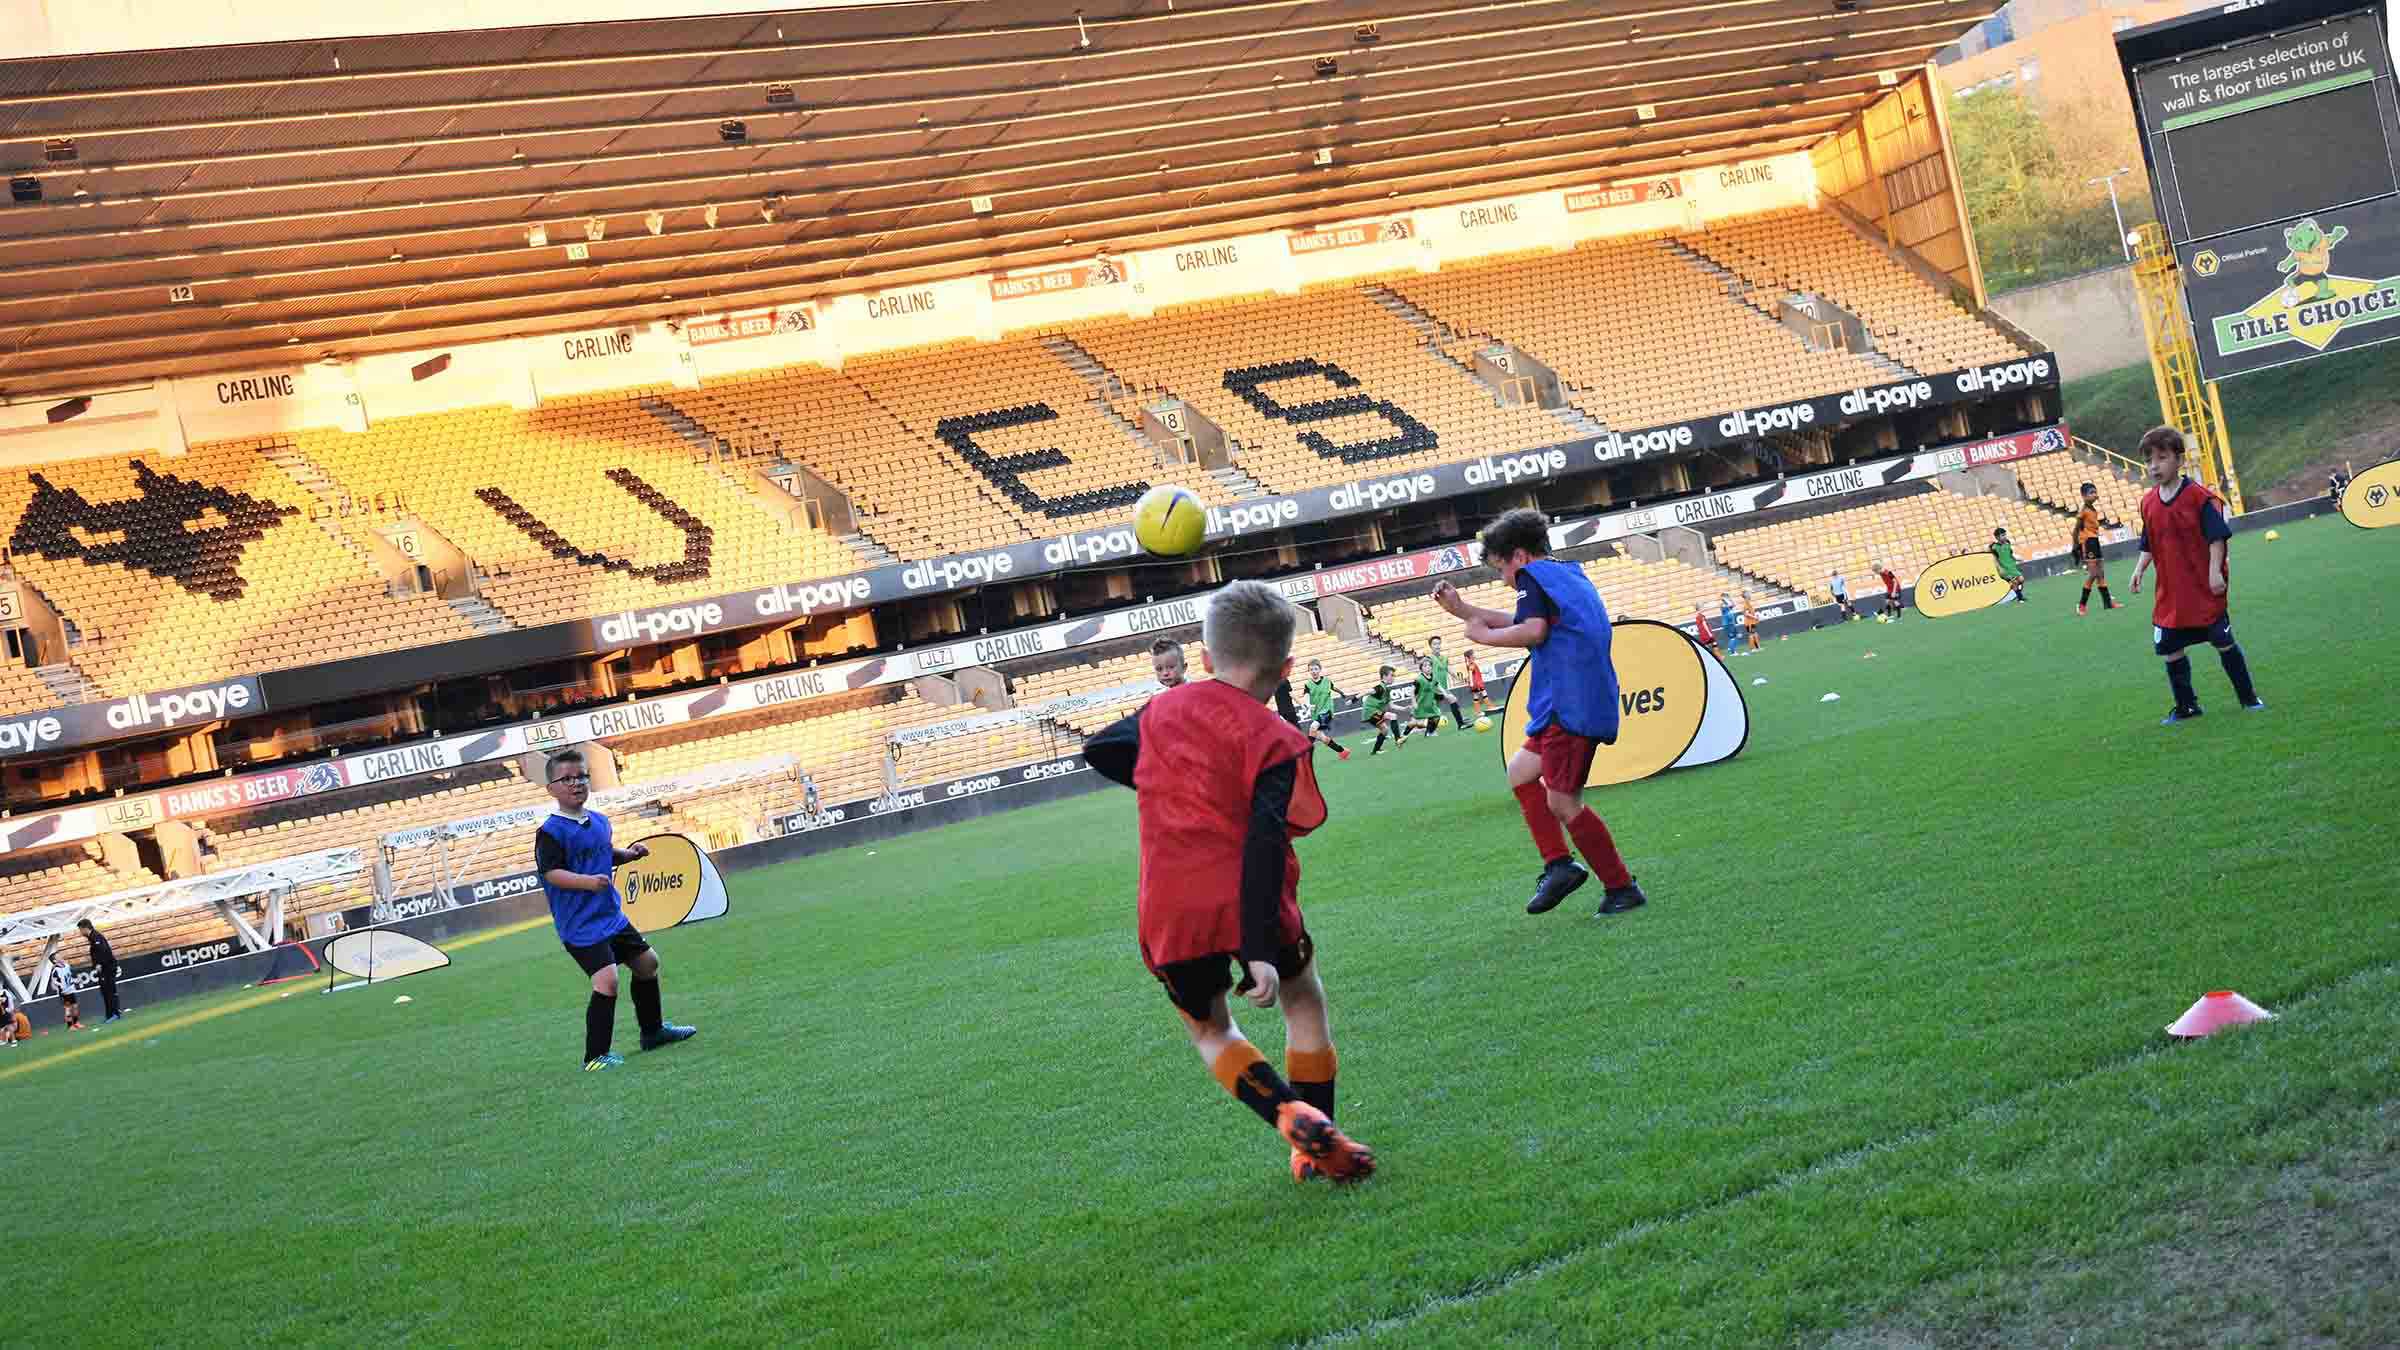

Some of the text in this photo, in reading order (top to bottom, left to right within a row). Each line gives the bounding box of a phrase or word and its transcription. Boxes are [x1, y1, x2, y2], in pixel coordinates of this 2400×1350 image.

[2168, 31, 2351, 90] The largest selection of
[2161, 48, 2367, 113] wall & floor tiles in the UK
[1719, 164, 1774, 189] CARLING
[1459, 202, 1518, 230] CARLING
[1175, 244, 1238, 272] CARLING
[171, 286, 191, 301] 12
[867, 290, 936, 319] CARLING
[2229, 287, 2399, 343] TILE CHOICE
[564, 331, 633, 361] CARLING
[216, 373, 295, 405] CARLING
[1955, 358, 2049, 393] all-paye
[344, 392, 361, 407] 13
[1839, 381, 1932, 416] all-paye
[1718, 403, 1815, 438] all-paye
[1593, 426, 1693, 462] all-paye
[1969, 438, 2018, 463] BANKS'S
[1463, 449, 1567, 486] all-paye
[1328, 474, 1436, 511] all-paye
[1674, 469, 1865, 524] CARLING CARLING
[1204, 498, 1299, 536] ll-paye
[1043, 530, 1137, 565] all-pay
[902, 550, 1013, 590] all-paye
[1322, 557, 1416, 593] BANKS'S BEER
[1951, 573, 1997, 592] Wolves
[755, 577, 871, 615] all-paye
[600, 602, 723, 642] all-paye
[974, 601, 1197, 664] CARLING CARLING
[925, 649, 948, 667] JL7
[106, 683, 250, 730] all-paye
[589, 671, 825, 737] CARLING CARLING
[1620, 686, 1665, 717] ves
[532, 724, 558, 743] JL6
[362, 744, 446, 780] CARLING
[1022, 759, 1076, 781] all-paye
[167, 774, 290, 817] BANKS'S BEER
[946, 774, 1001, 798] all-paye
[114, 804, 145, 822] JL5
[474, 873, 538, 899] all-paye
[642, 871, 684, 894] Wolves
[160, 940, 231, 968] all-paye
